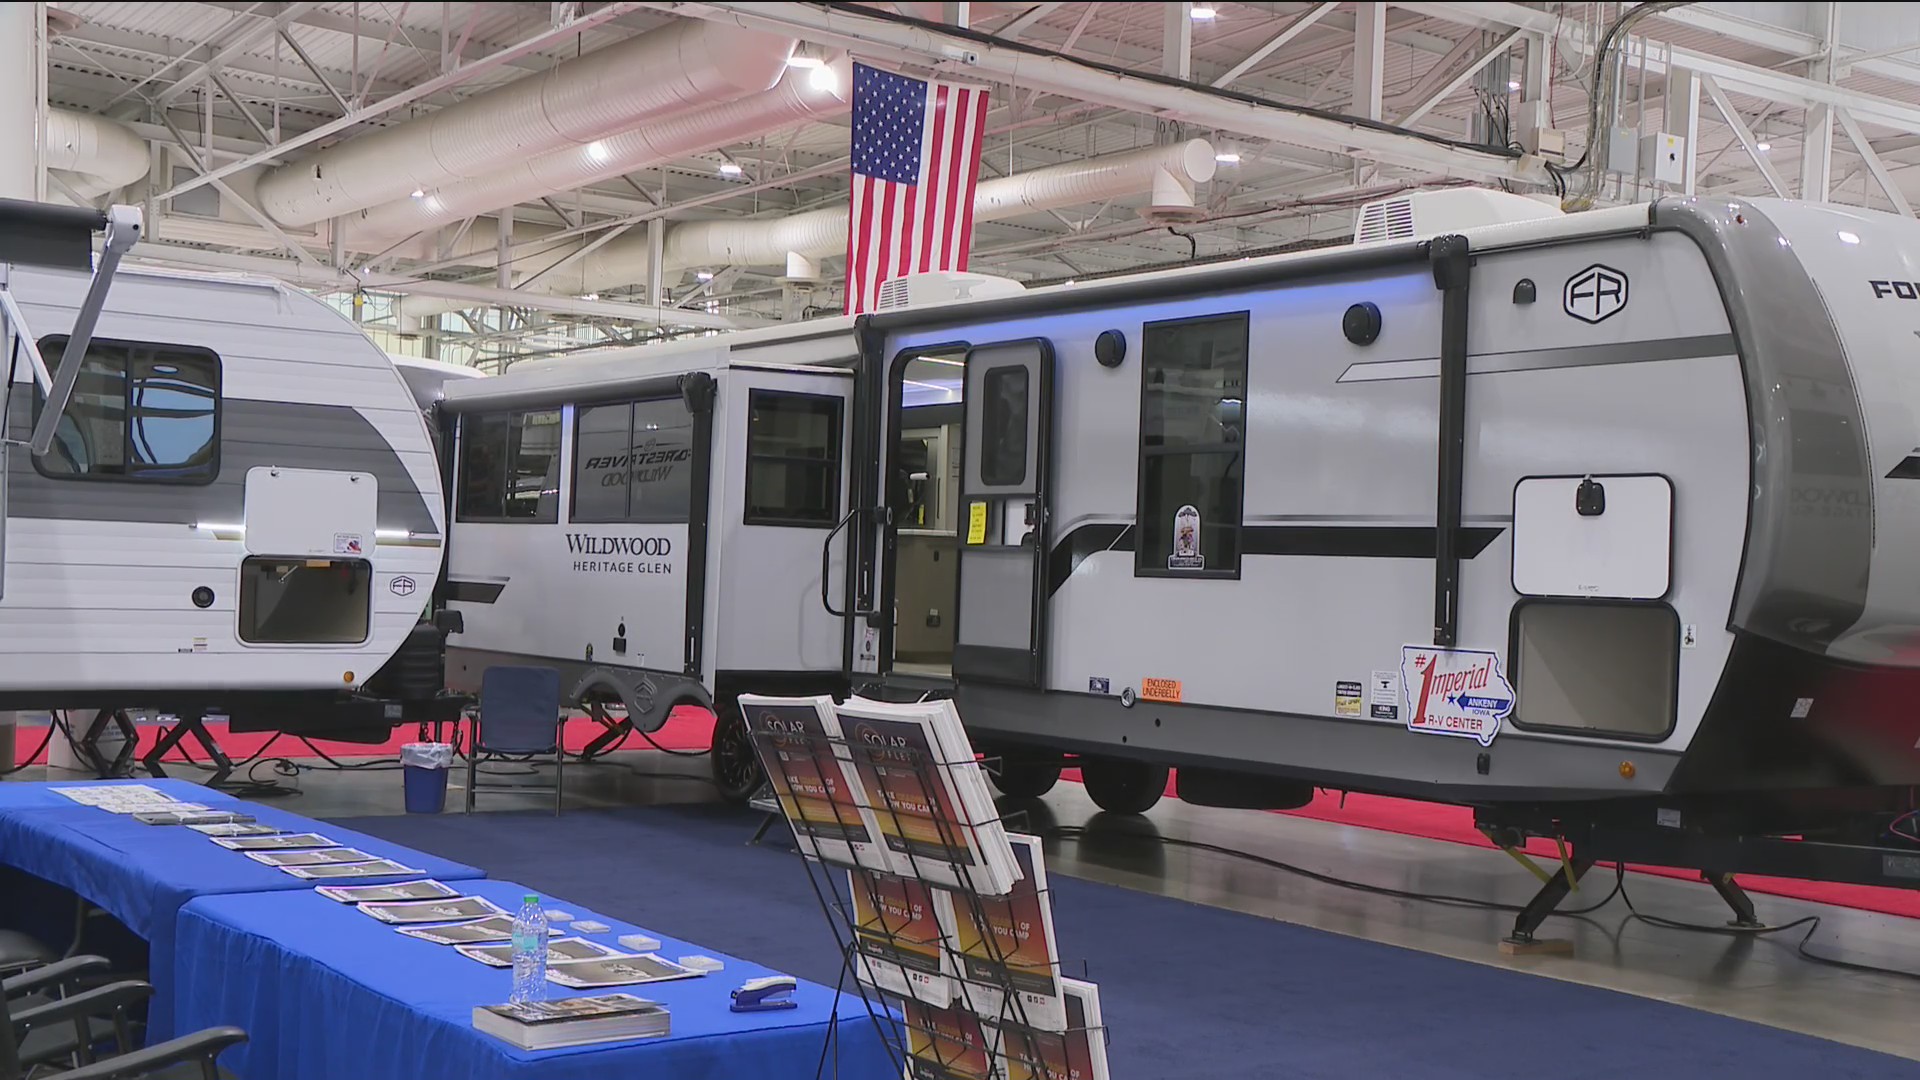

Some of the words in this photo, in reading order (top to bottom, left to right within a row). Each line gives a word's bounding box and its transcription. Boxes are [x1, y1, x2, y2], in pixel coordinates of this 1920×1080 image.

[1868, 280, 1920, 299] FO
[573, 561, 634, 573] HERITAGE
[637, 563, 672, 574] GLEN
[1147, 678, 1177, 689] ENCLOSED
[1142, 687, 1181, 699] UNDERBELLY
[1467, 698, 1498, 709] ANKENY
[1472, 709, 1491, 717] IOWA
[1428, 714, 1445, 726] R-V
[1446, 717, 1483, 730] CENTER
[901, 801, 917, 811] YOU
[888, 905, 902, 916] YOU
[993, 926, 1008, 936] YOU
[1020, 921, 1030, 931] OF
